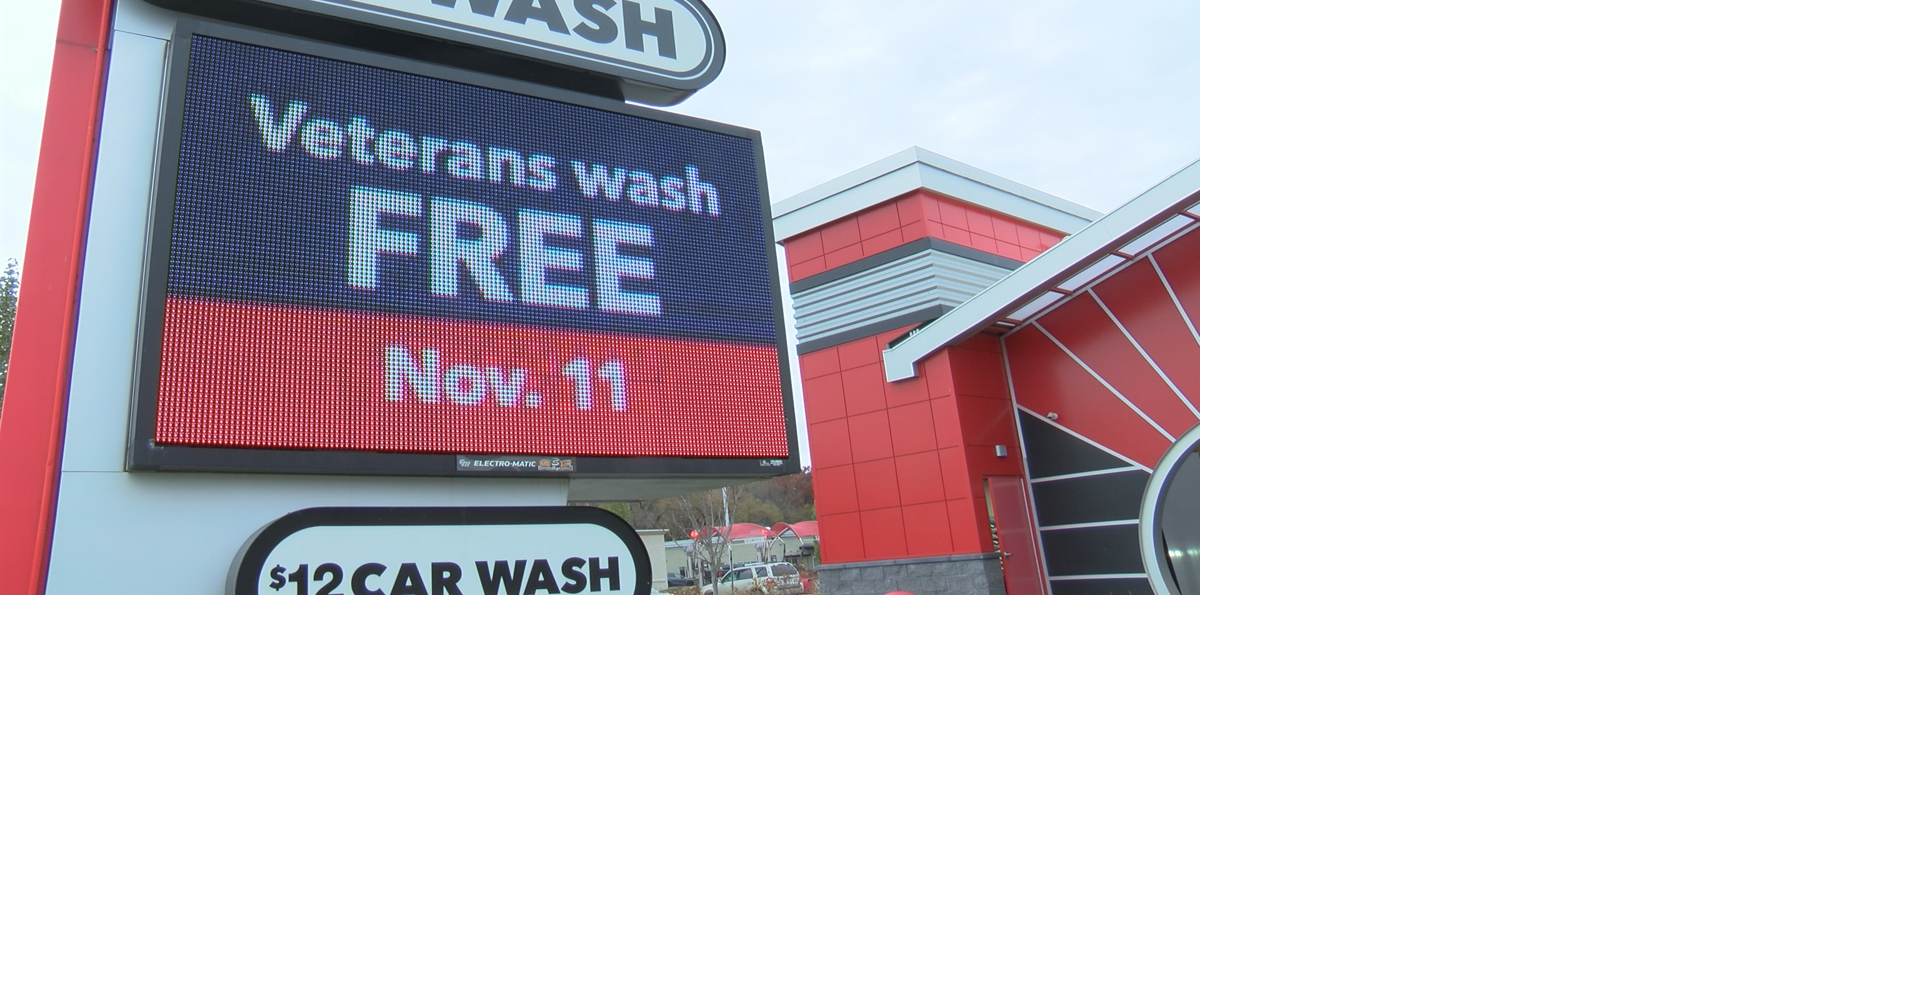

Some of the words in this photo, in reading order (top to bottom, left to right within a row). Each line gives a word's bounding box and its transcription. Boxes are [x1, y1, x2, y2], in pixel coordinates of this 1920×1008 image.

[250, 94, 558, 191] Veterans
[571, 160, 720, 217] wash
[347, 185, 661, 317] FREE
[384, 344, 543, 408] Nov.
[561, 356, 628, 412] 11
[269, 562, 344, 595] $12
[351, 562, 463, 595] CAR
[475, 556, 620, 595] WASH
